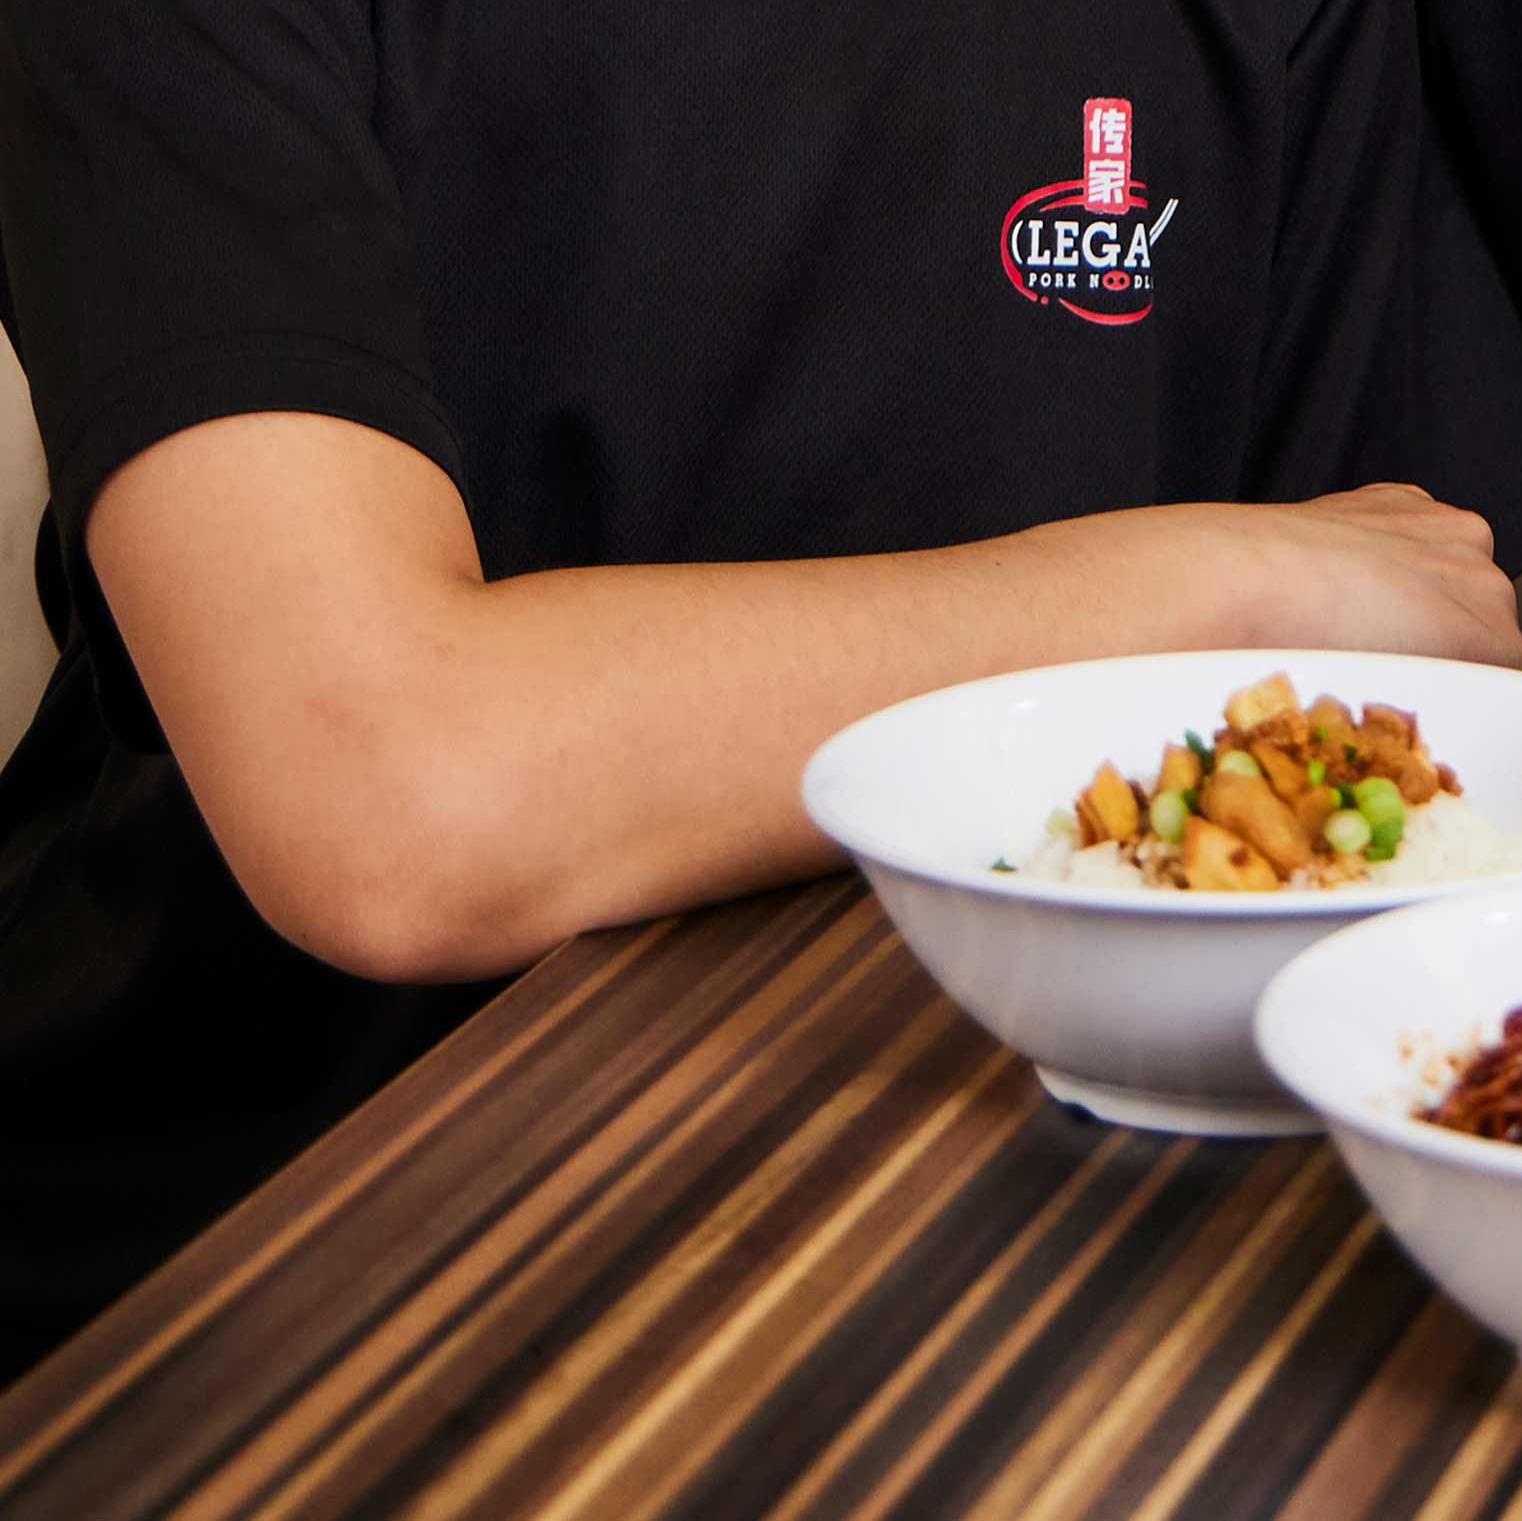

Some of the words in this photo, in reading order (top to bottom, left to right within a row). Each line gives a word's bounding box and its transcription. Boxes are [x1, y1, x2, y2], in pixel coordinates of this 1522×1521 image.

[1088, 107, 1127, 205] 传家
[1027, 218, 1153, 269] LEGA
[1028, 272, 1077, 289] PORK
[1089, 270, 1154, 291] NOODL
